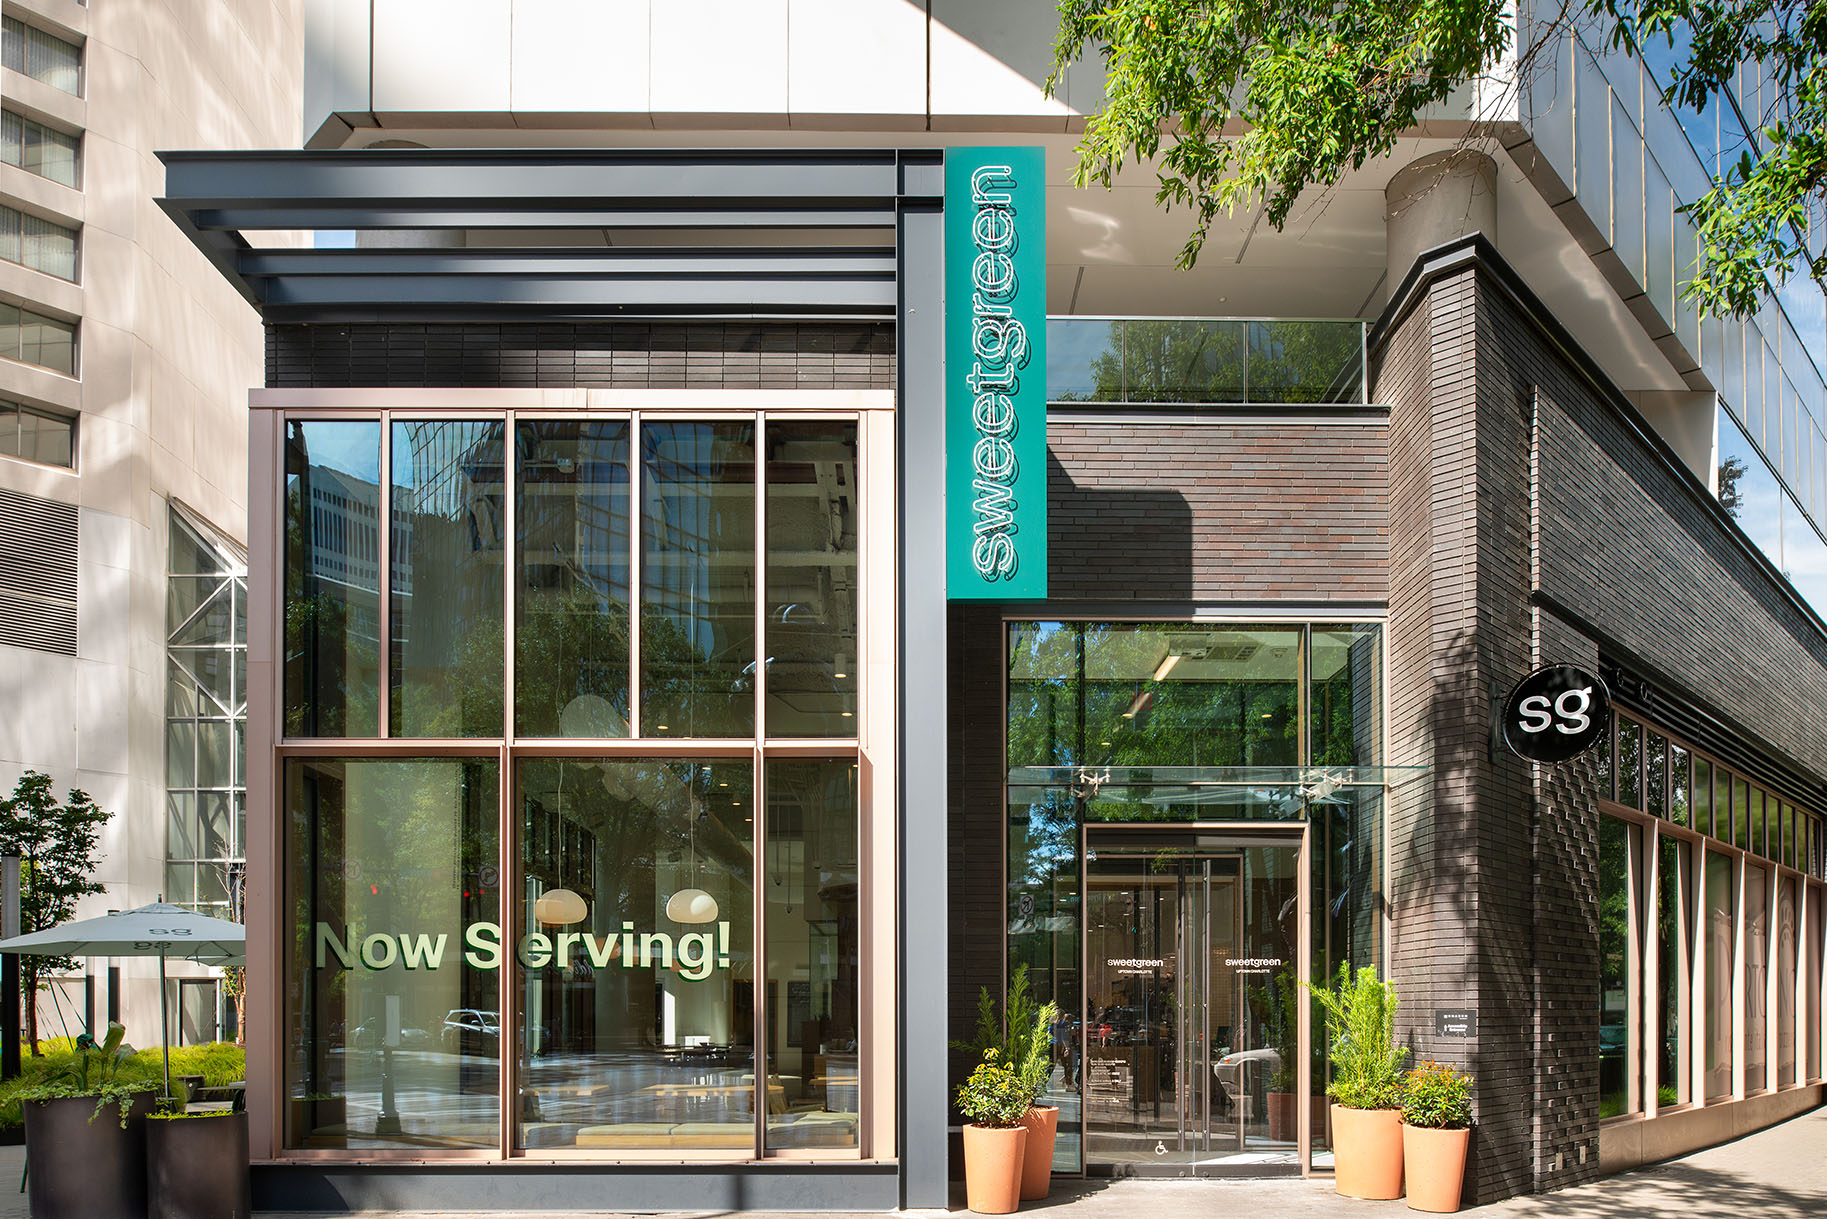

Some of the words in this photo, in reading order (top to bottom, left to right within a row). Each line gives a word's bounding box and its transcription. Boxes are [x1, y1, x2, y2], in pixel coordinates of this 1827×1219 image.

[967, 164, 1027, 573] sweetgreen
[1519, 686, 1592, 735] sg
[315, 921, 448, 970] Now
[464, 920, 730, 981] Serving!
[1107, 958, 1164, 968] sweetgreen
[1225, 958, 1281, 968] sweetgreen
